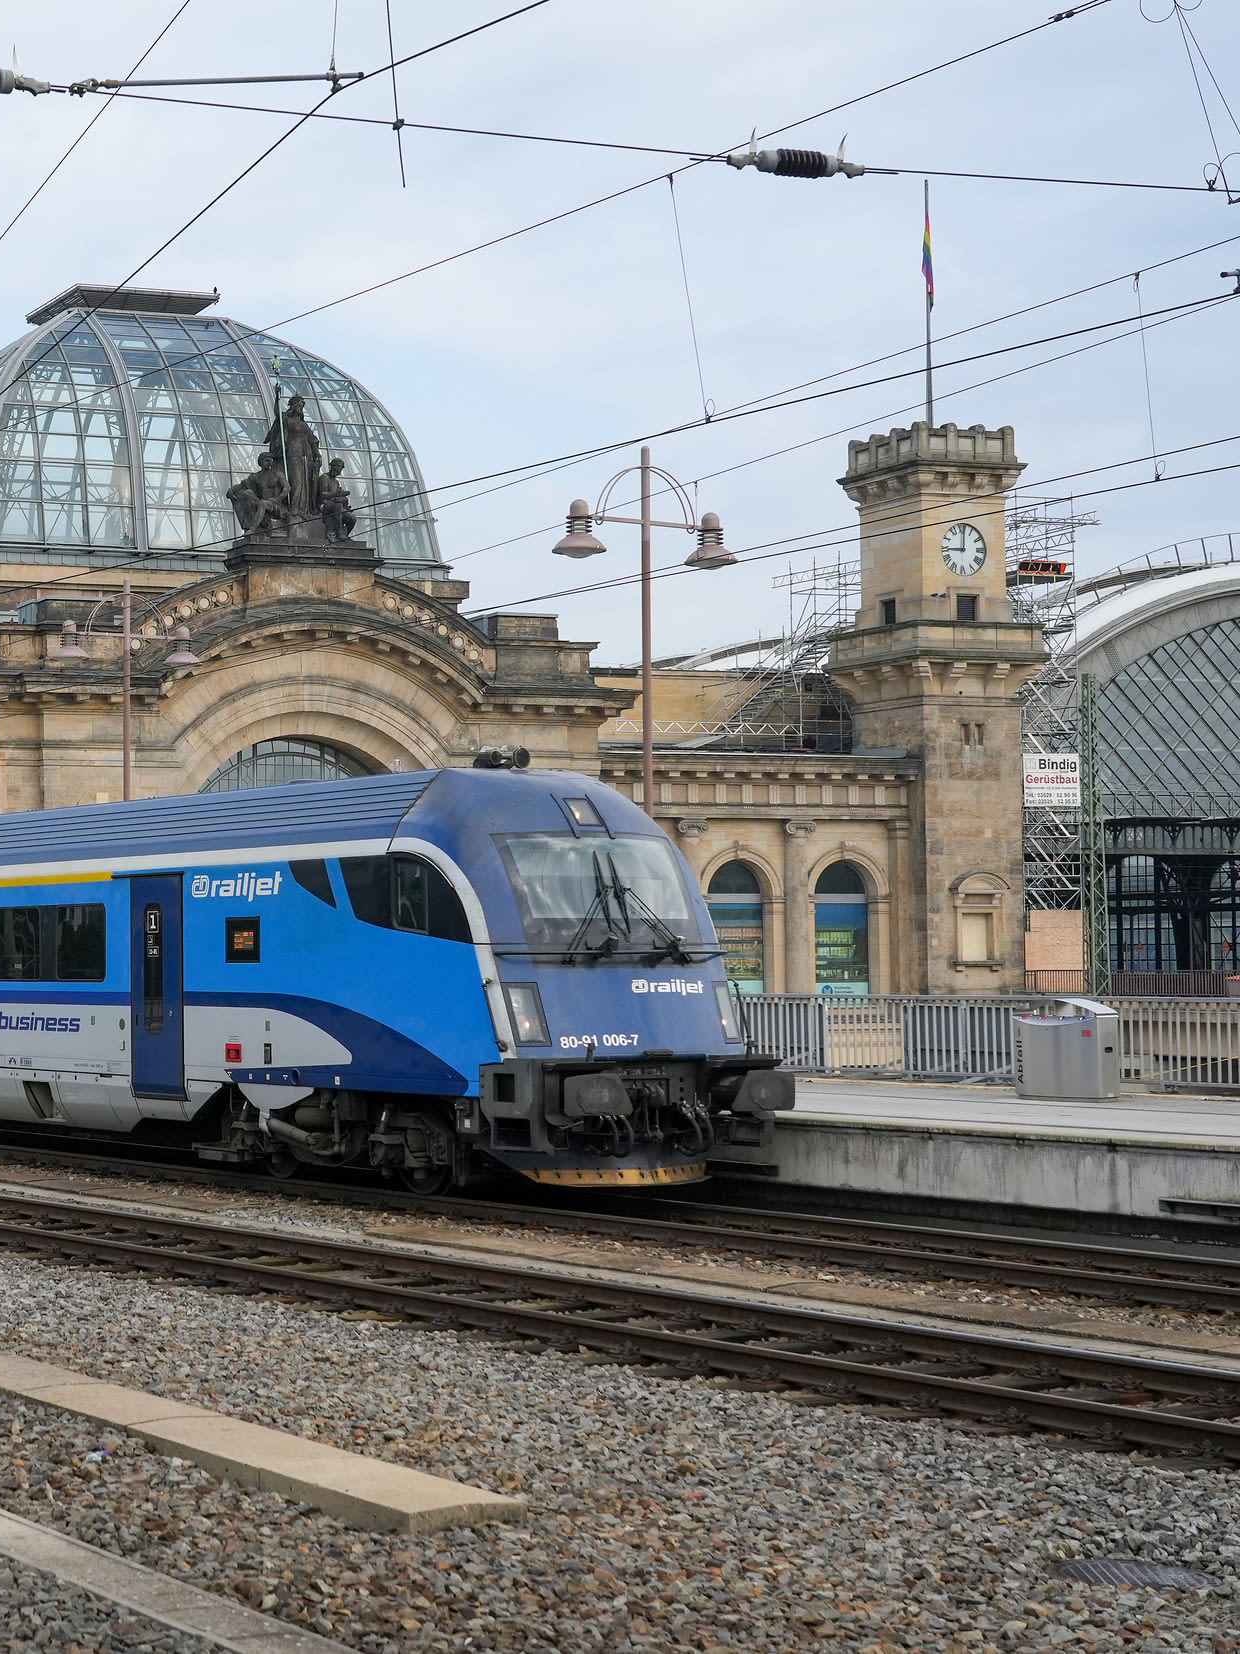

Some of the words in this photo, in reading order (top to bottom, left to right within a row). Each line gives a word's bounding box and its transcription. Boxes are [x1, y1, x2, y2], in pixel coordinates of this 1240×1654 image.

[1038, 758, 1076, 772] Bindig
[1026, 774, 1078, 784] Gerüstbau
[211, 871, 282, 902] railjet
[650, 979, 704, 996] railjet
[560, 1035, 598, 1048] 80-91
[603, 1034, 639, 1047] 006-7
